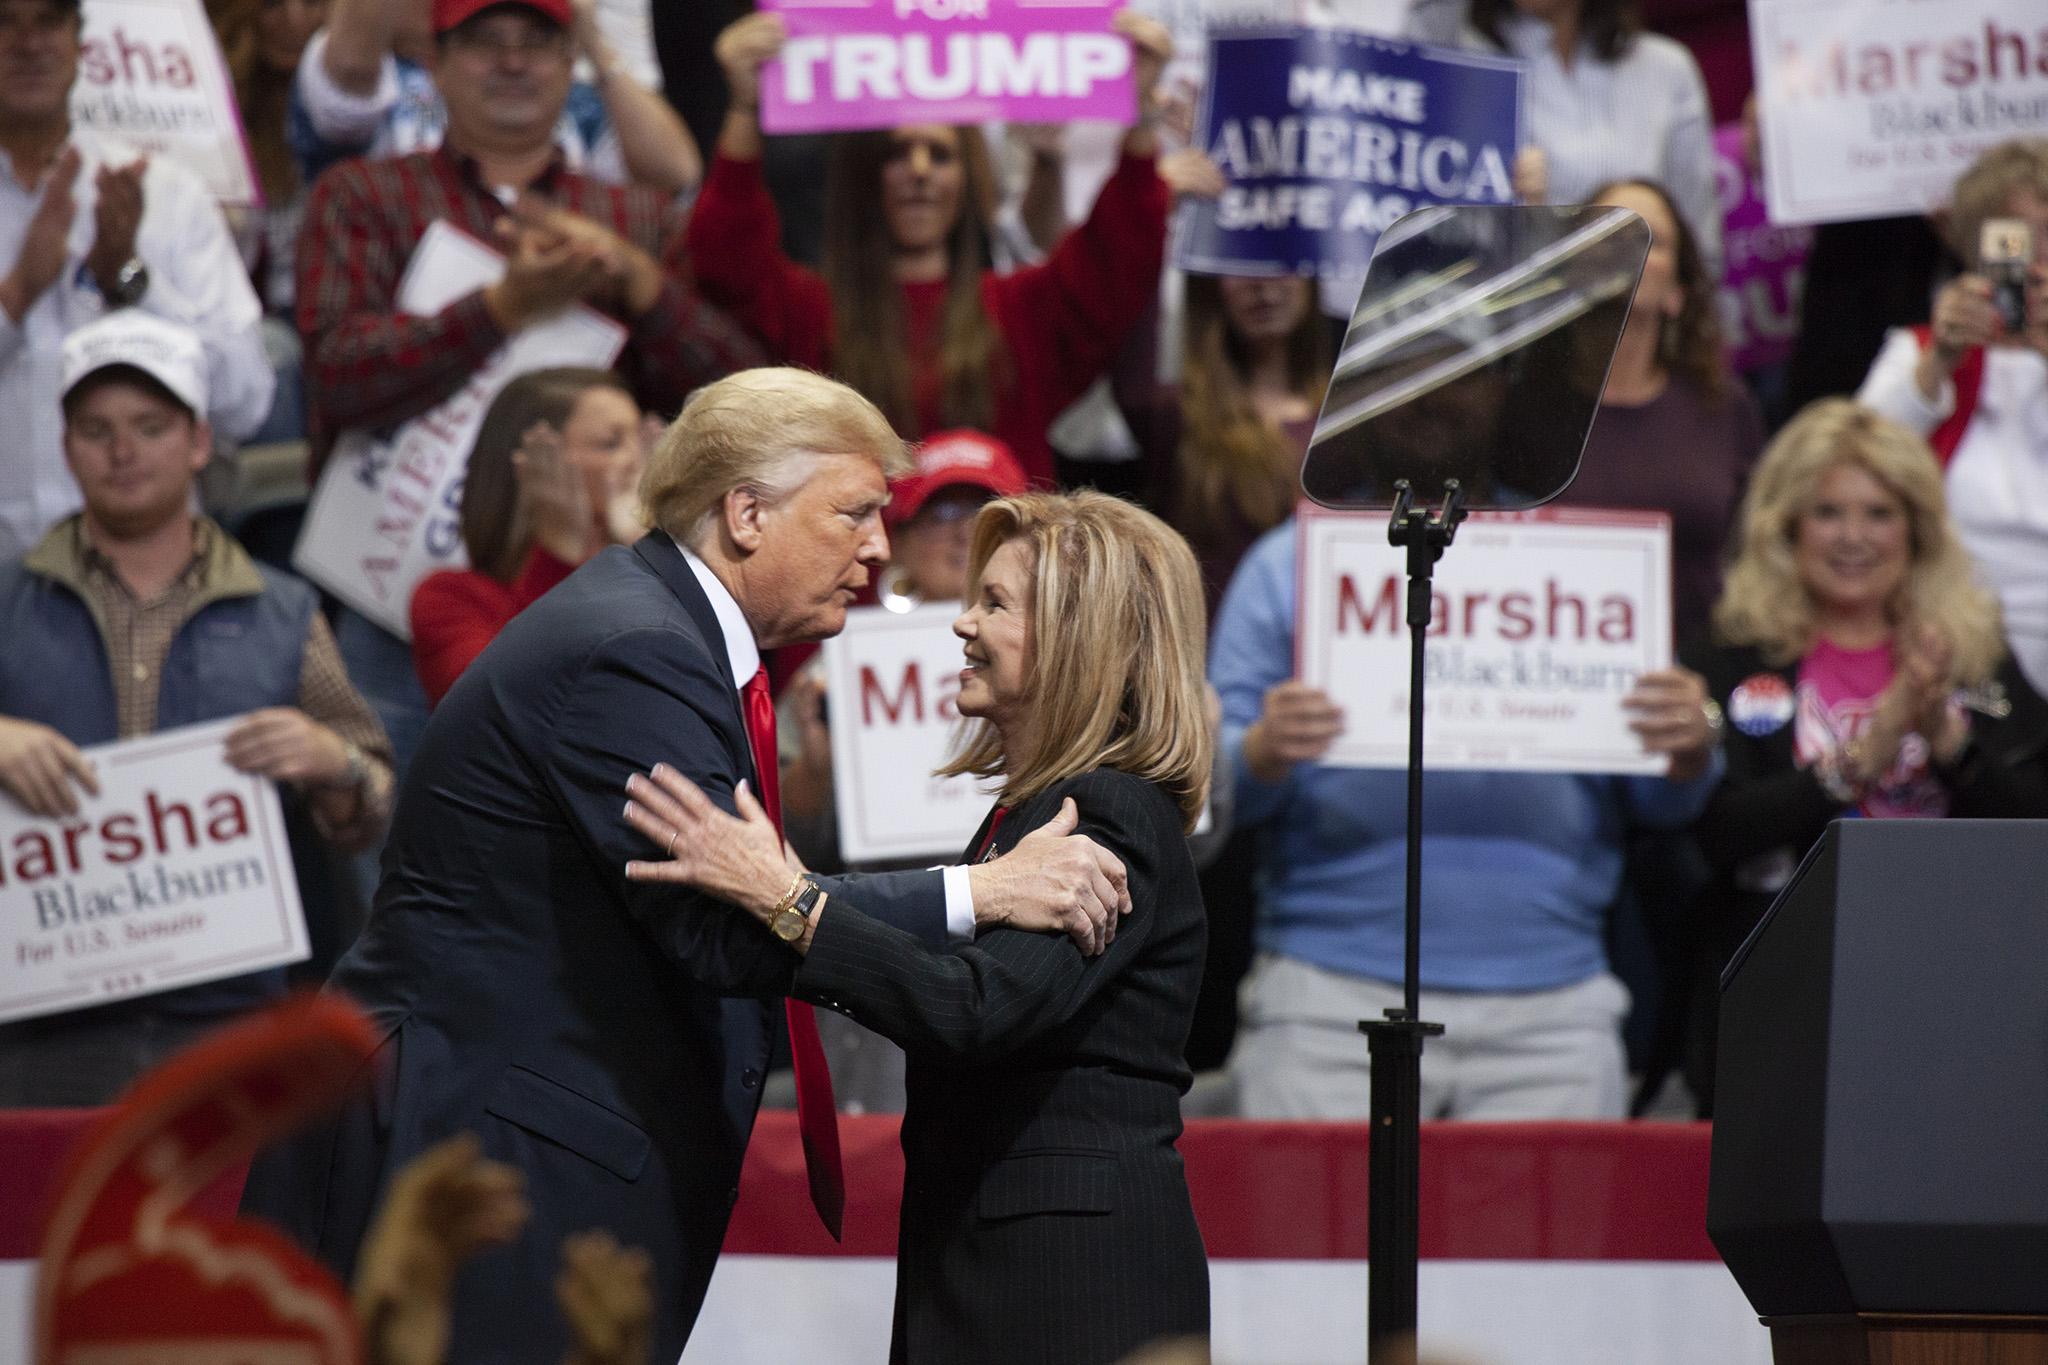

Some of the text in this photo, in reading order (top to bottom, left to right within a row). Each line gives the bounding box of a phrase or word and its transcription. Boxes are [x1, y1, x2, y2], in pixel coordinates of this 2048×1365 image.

[80, 27, 195, 88] sha
[781, 33, 1132, 103] TRUMP
[1780, 20, 2048, 97] Marsh
[1287, 65, 1426, 124] MAKE
[1208, 114, 1514, 203] AMERICA
[1217, 186, 1332, 231] SAFE
[1336, 572, 1636, 643] Marsha
[0, 790, 249, 885] arsha
[33, 856, 265, 930] Blackburn
[121, 911, 206, 943] Senate
